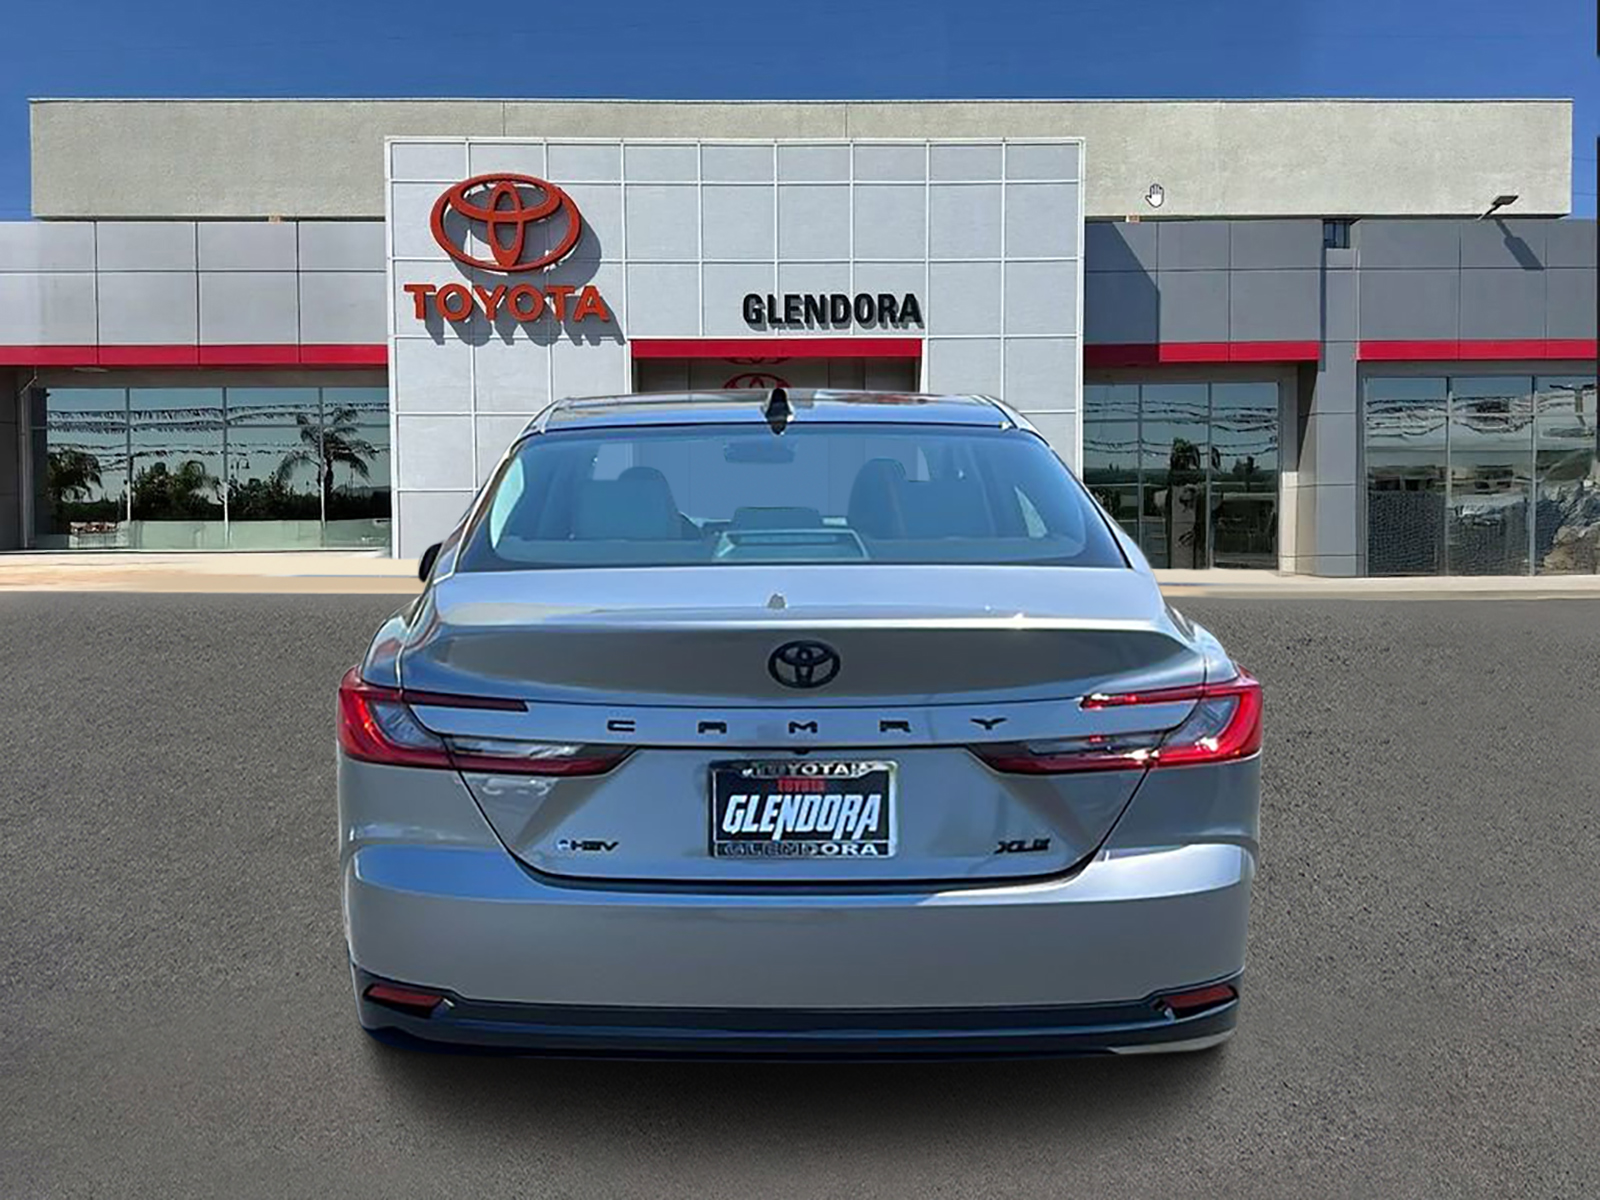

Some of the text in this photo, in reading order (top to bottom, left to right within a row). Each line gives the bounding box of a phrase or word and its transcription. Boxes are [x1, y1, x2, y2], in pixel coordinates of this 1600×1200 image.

[404, 284, 611, 322] TOYOTA
[743, 293, 923, 326] GLENDORA
[607, 718, 1007, 734] CAMRY
[756, 762, 849, 776] TOYOTA
[722, 795, 882, 841] GLENDORA
[724, 843, 878, 856] GLENDORA
[993, 838, 1051, 855] XLE
